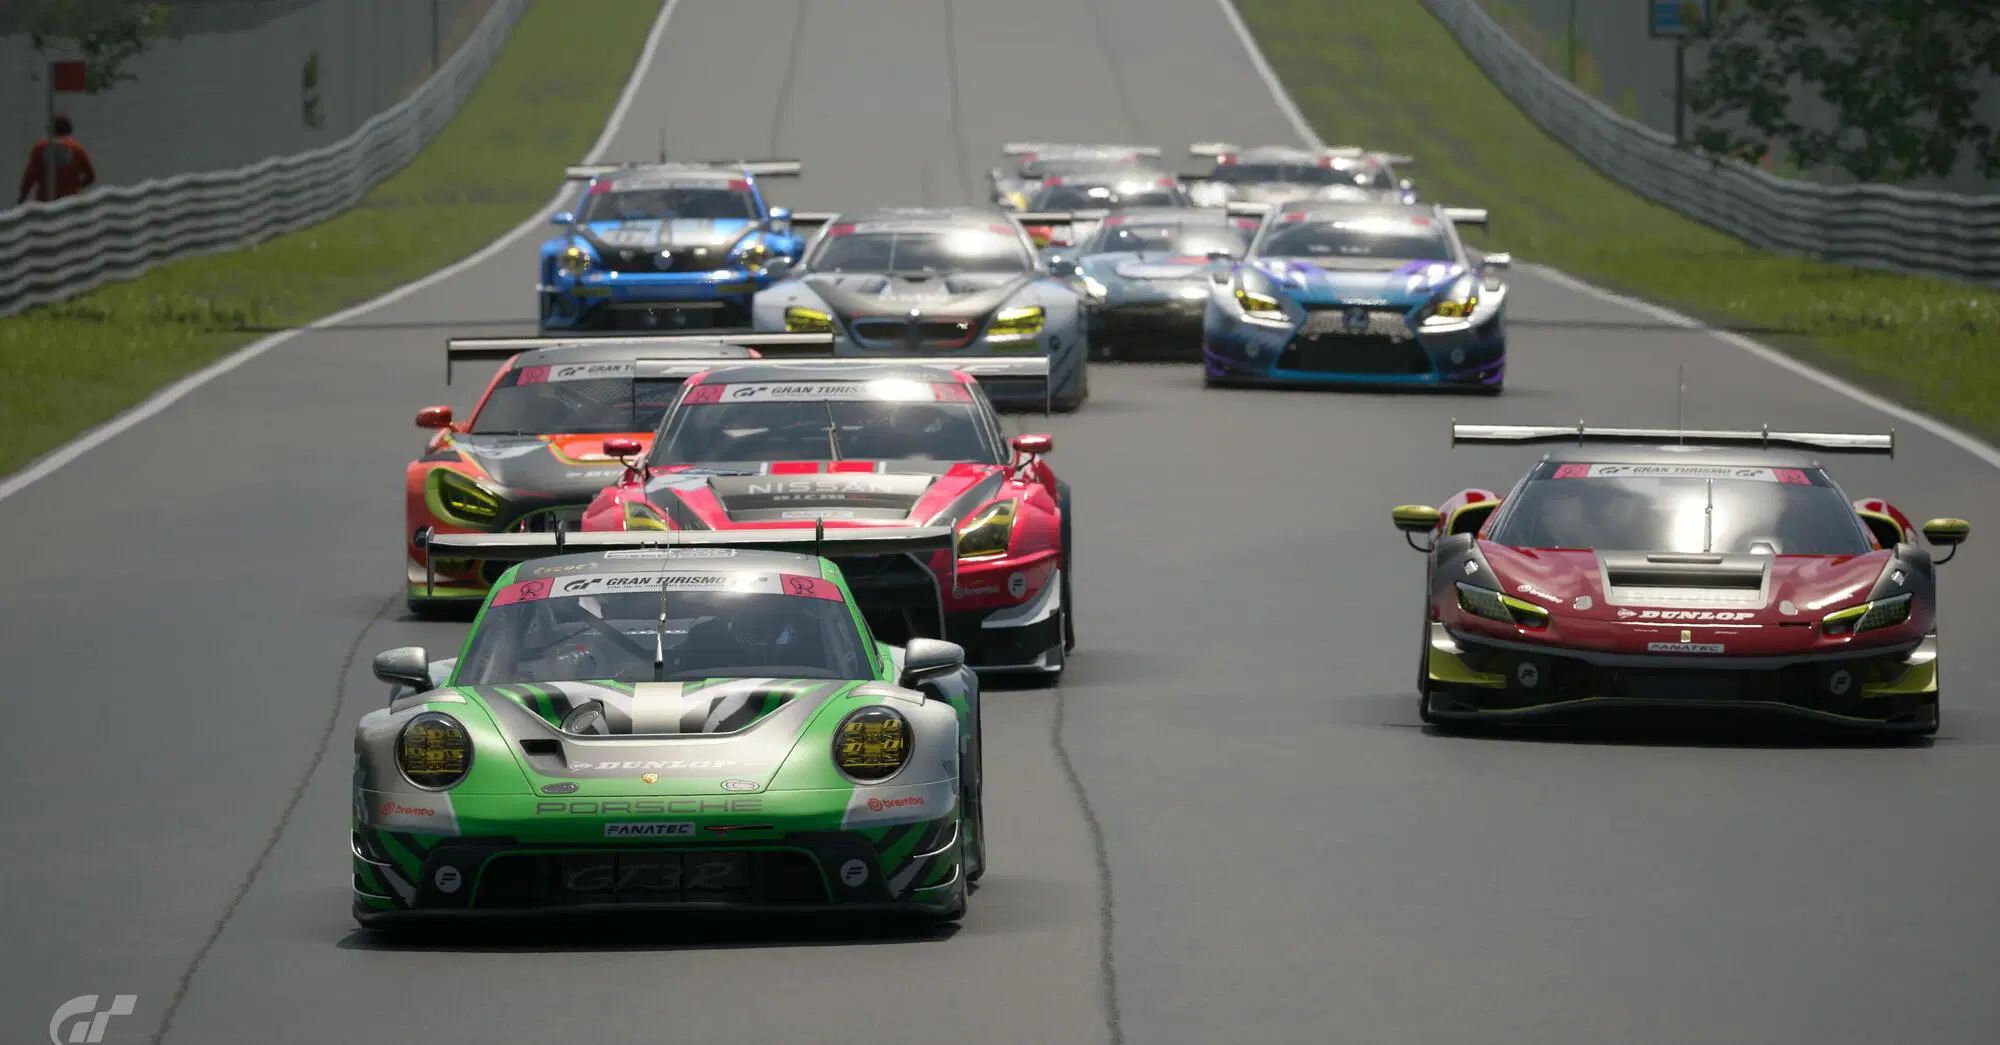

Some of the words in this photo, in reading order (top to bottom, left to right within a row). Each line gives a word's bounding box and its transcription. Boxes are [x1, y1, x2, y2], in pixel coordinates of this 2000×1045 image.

[588, 365, 621, 373] GRAN
[771, 386, 812, 395] GRAN
[749, 480, 892, 494] NISSAN
[606, 576, 652, 586] GRAN
[656, 575, 727, 585] TURISMO
[1638, 610, 1755, 621] DUNLOP
[1650, 643, 1720, 651] FANATEC
[597, 760, 735, 770] DUNLOP
[536, 799, 763, 815] PORSCHE
[882, 797, 925, 808] brembo
[395, 805, 435, 816] brembo
[607, 824, 690, 835] FANATEC
